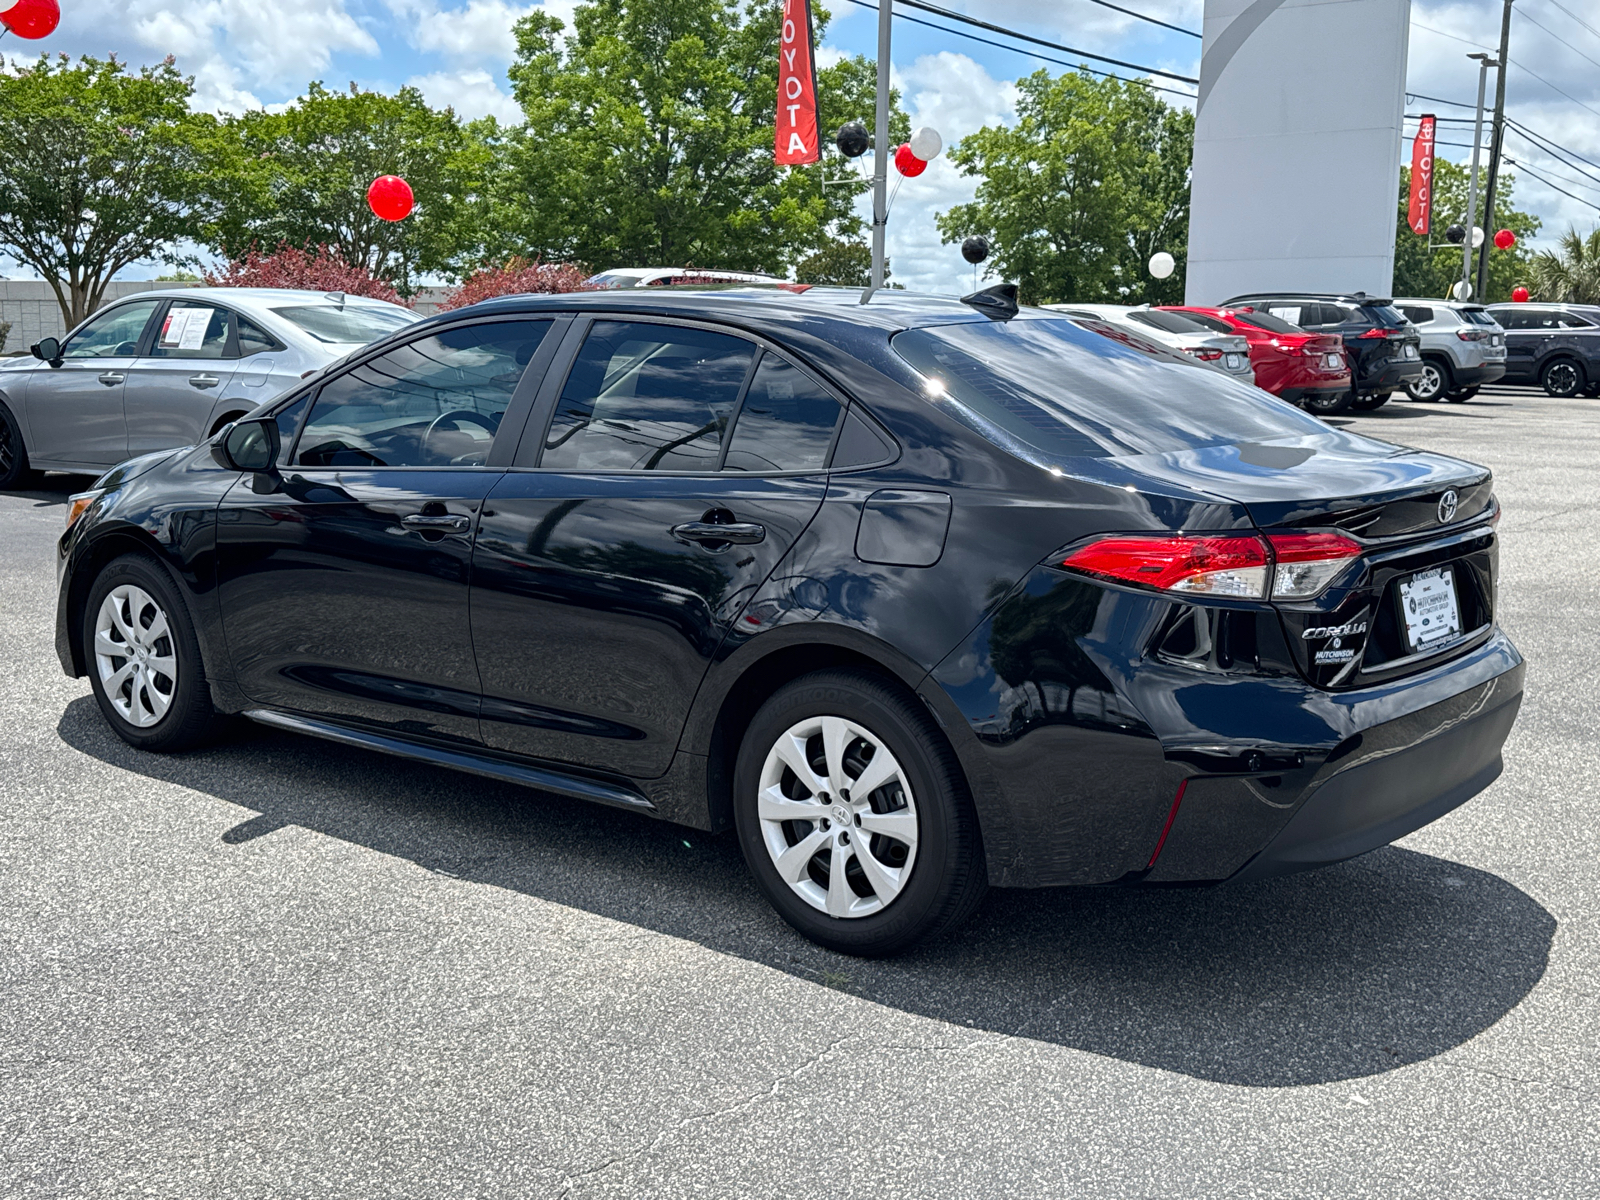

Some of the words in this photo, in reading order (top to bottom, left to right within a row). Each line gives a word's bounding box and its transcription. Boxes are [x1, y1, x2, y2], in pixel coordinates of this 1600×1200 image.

[1414, 142, 1433, 231] TOYOTA
[1302, 622, 1367, 639] COROLLA
[1315, 649, 1355, 660] HUTCHINSON
